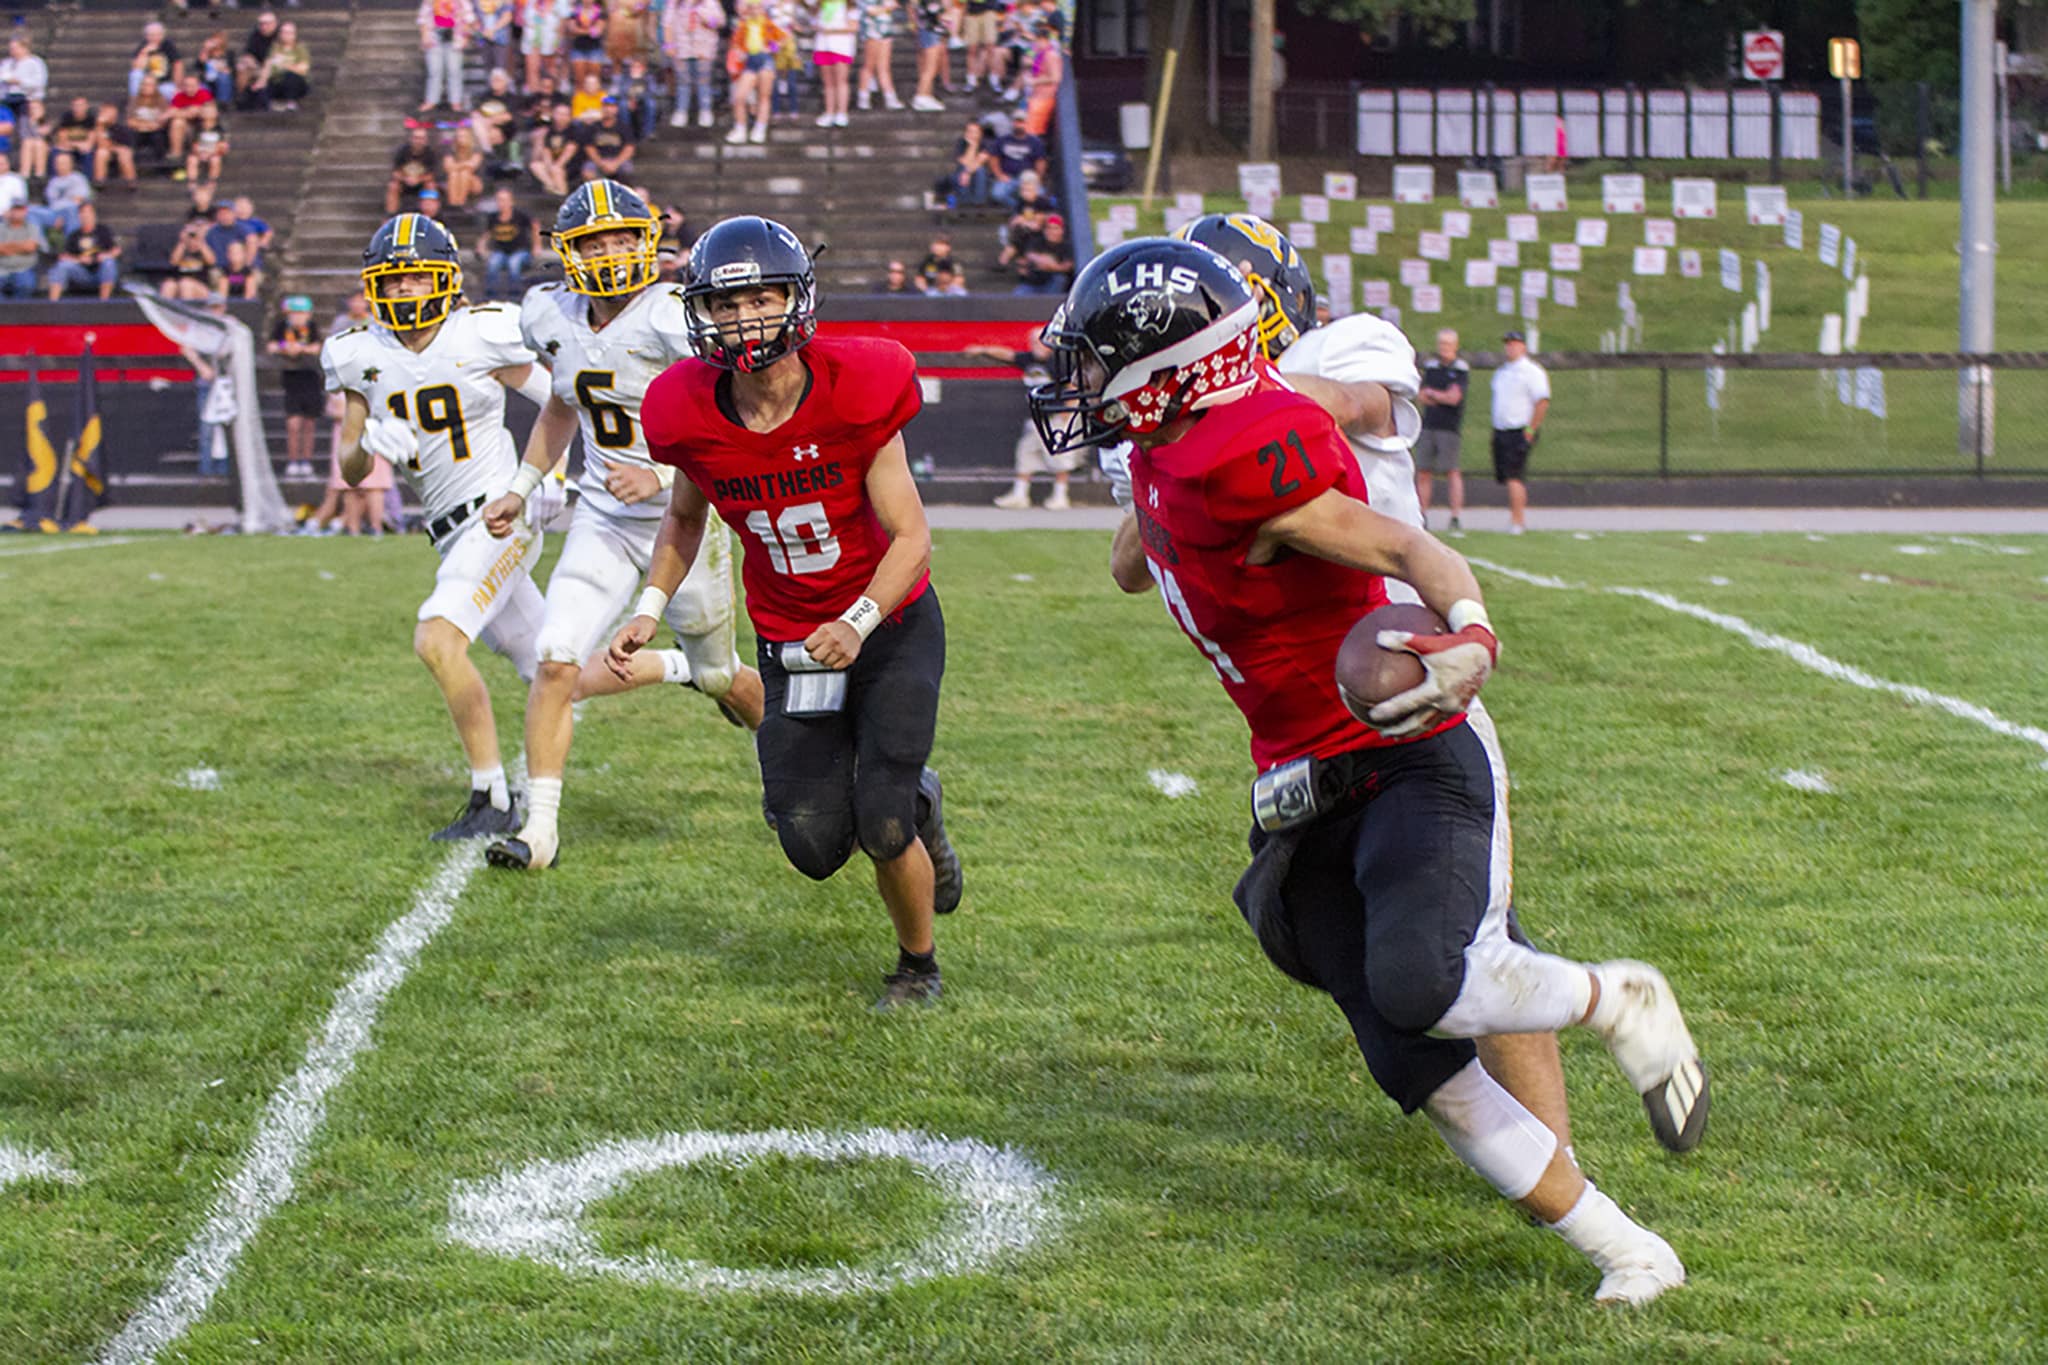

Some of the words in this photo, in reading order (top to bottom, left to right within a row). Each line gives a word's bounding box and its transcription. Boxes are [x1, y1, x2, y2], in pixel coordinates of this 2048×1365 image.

[1107, 263, 1199, 296] LHS
[574, 369, 636, 449] 6
[712, 461, 845, 502] PANTHERS
[1257, 428, 1318, 498] 21
